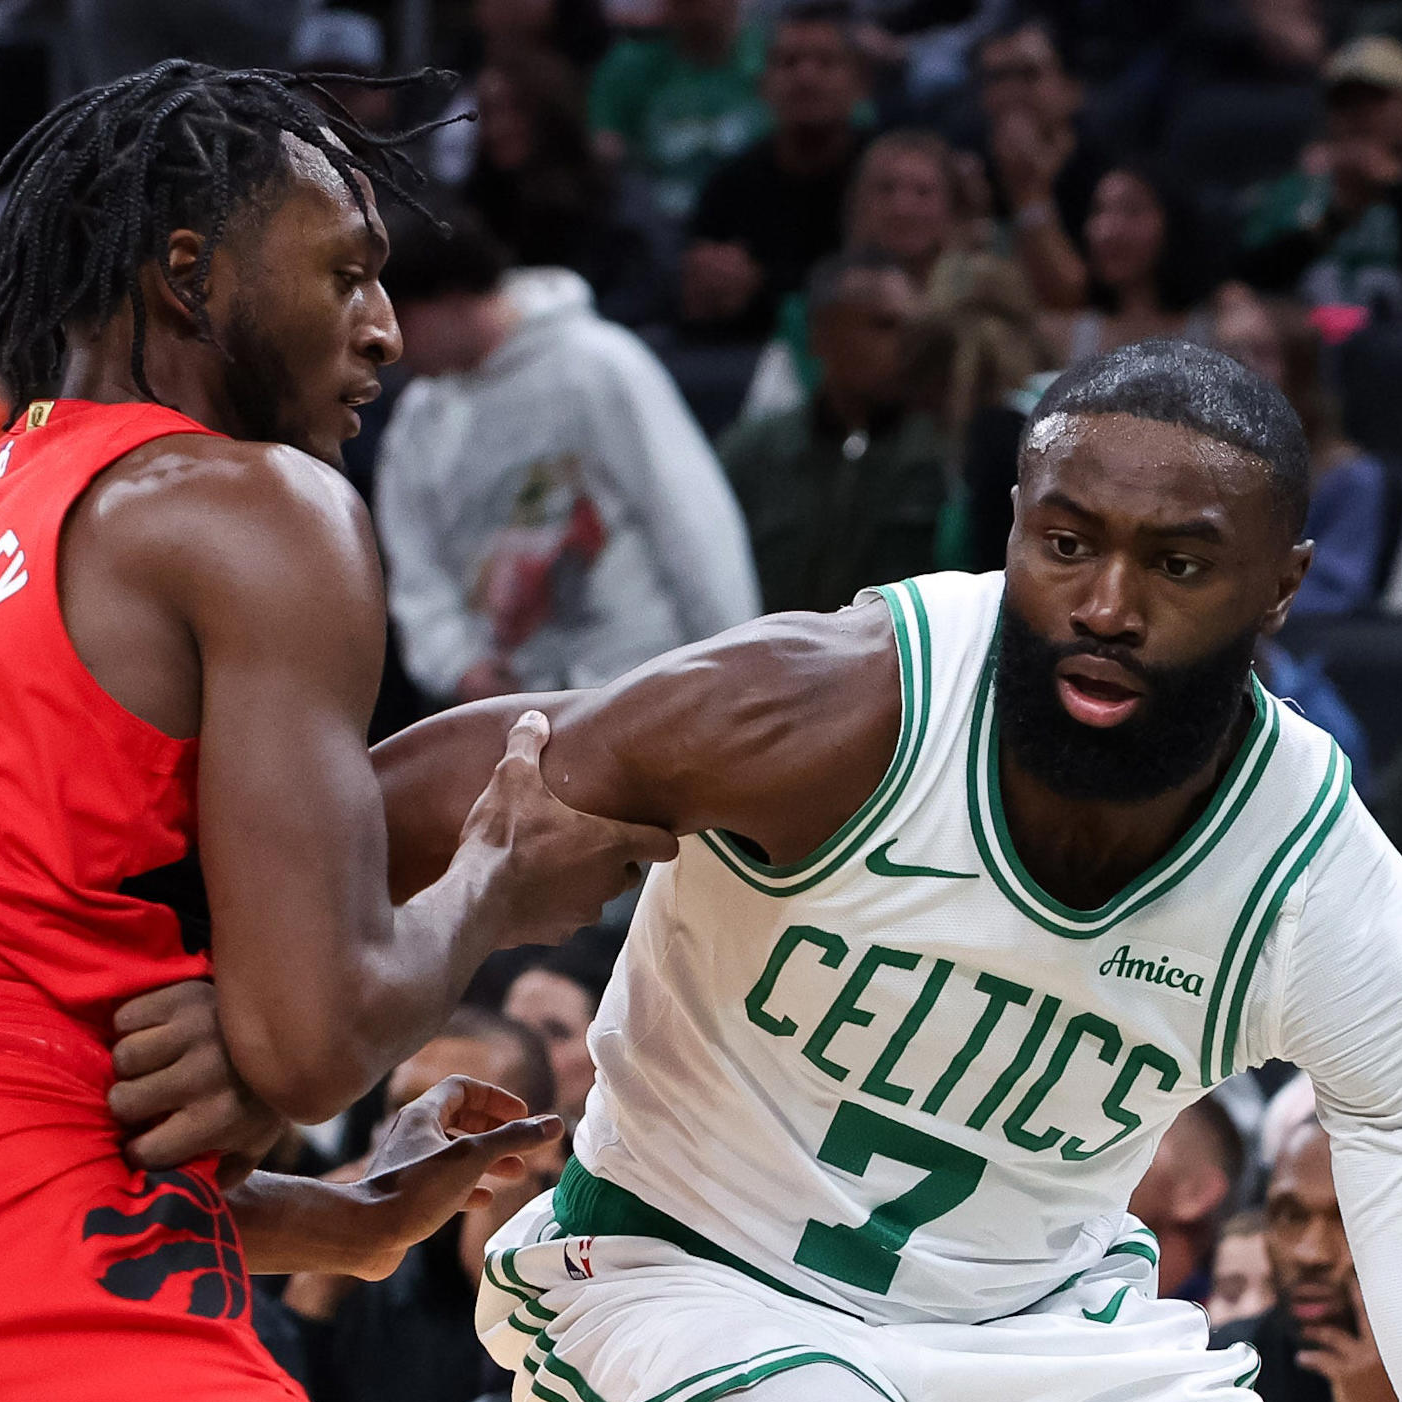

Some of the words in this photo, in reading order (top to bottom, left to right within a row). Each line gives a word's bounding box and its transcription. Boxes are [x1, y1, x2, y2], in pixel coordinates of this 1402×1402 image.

[745, 925, 1182, 1161] CELTICS
[1099, 945, 1205, 997] Amica
[792, 1099, 988, 1296] 7
